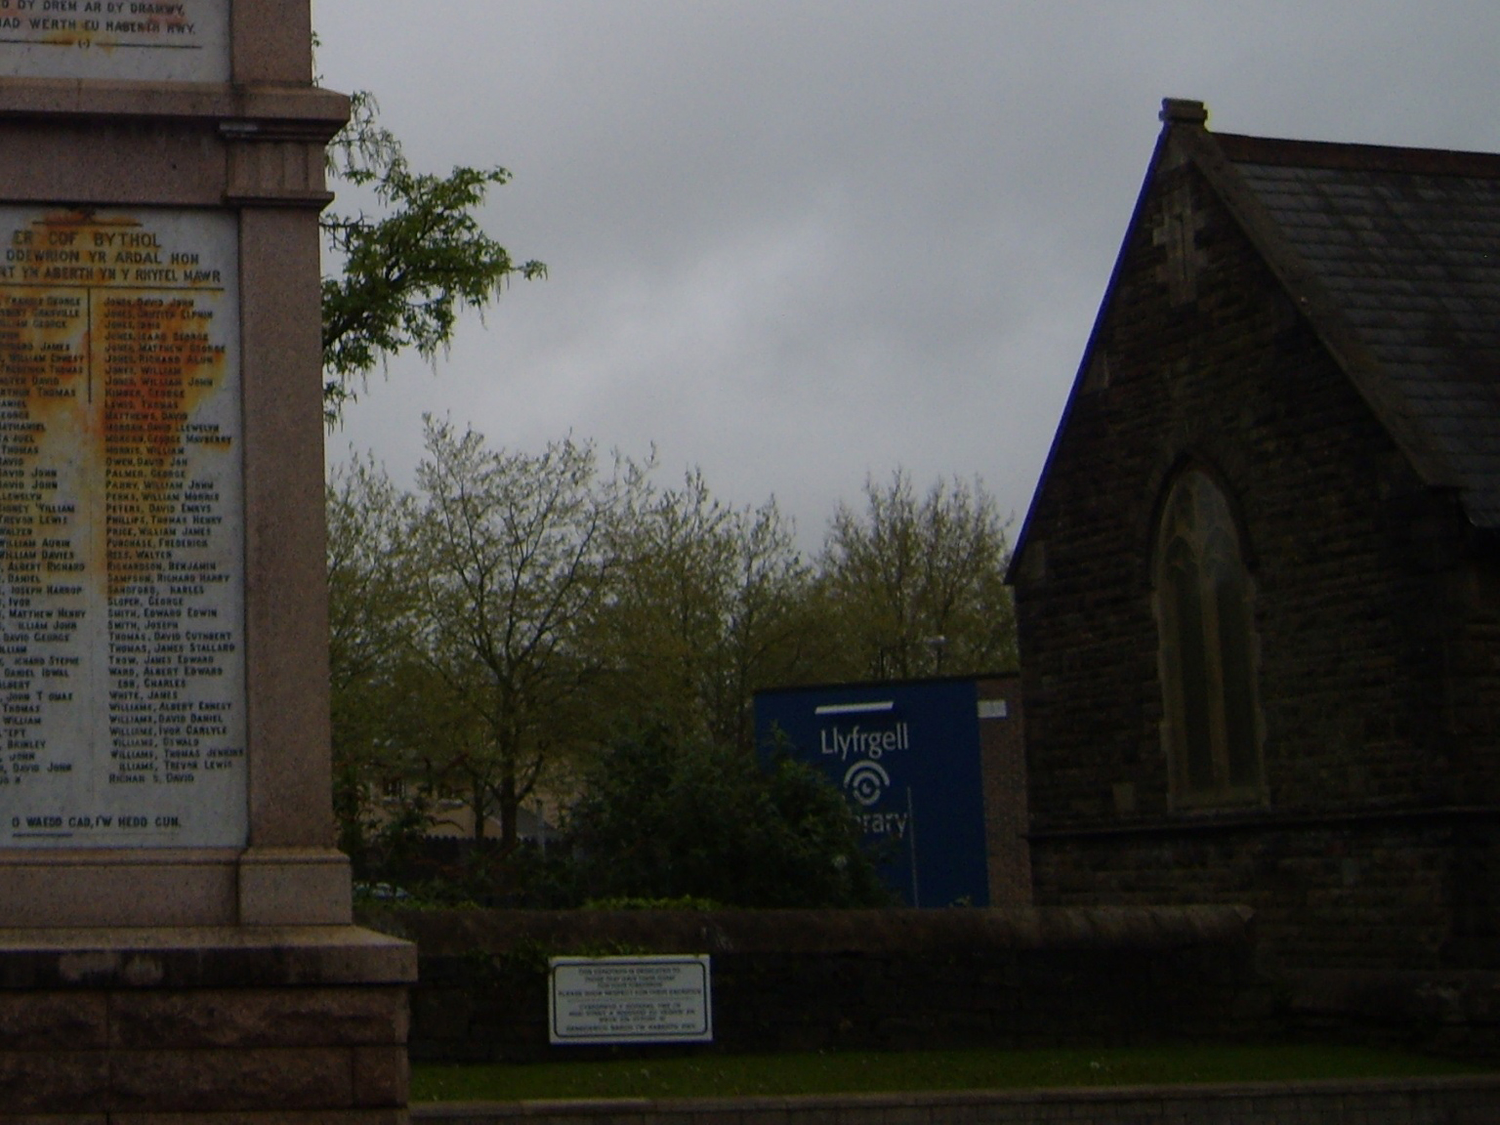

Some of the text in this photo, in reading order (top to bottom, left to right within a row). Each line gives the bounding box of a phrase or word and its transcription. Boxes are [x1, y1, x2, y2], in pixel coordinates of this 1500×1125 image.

[17, 0, 35, 10] DY
[43, 0, 77, 12] DREM
[85, 1, 101, 12] AR
[30, 17, 76, 30] WERTH
[13, 230, 161, 248] ER COF BYTHOL
[6, 250, 80, 262] DDEWRION
[89, 251, 106, 263] YR
[115, 252, 162, 264] ARDAL
[171, 253, 199, 264] HON
[100, 268, 116, 280] YN
[122, 269, 129, 280] Y
[135, 269, 177, 282] RHYFEL
[184, 270, 221, 282] MAWR
[821, 722, 909, 760] Llyfrgell
[12, 817, 20, 828] O
[26, 817, 62, 827] WAEDD
[118, 817, 148, 827] HEDD
